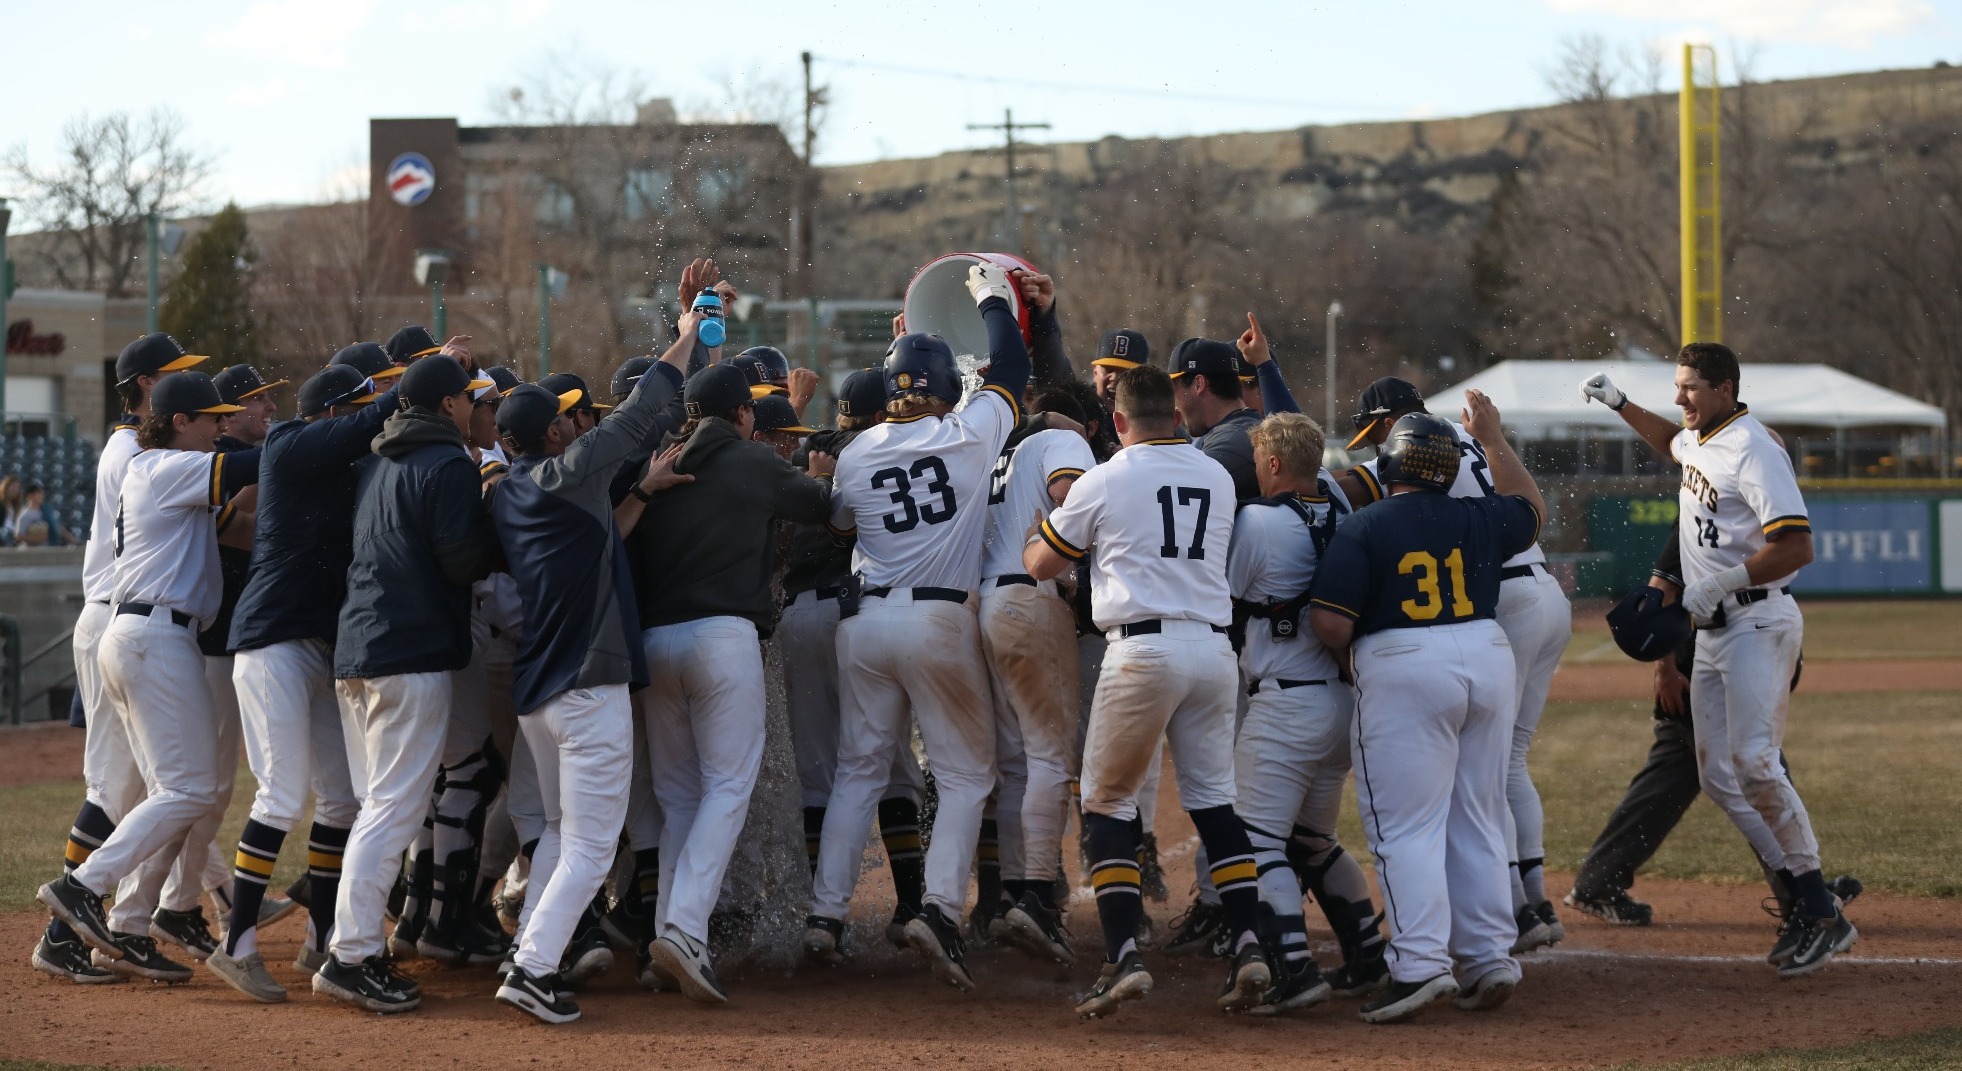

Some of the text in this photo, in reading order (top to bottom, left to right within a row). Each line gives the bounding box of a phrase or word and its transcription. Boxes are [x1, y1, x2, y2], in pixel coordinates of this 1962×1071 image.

[1114, 335, 1130, 357] B
[871, 455, 958, 534] 33
[1680, 464, 1718, 513] CKETS
[1157, 485, 1211, 560] 17
[1694, 515, 1719, 549] 14
[1812, 530, 1921, 561] PFLI
[1398, 548, 1474, 620] 31
